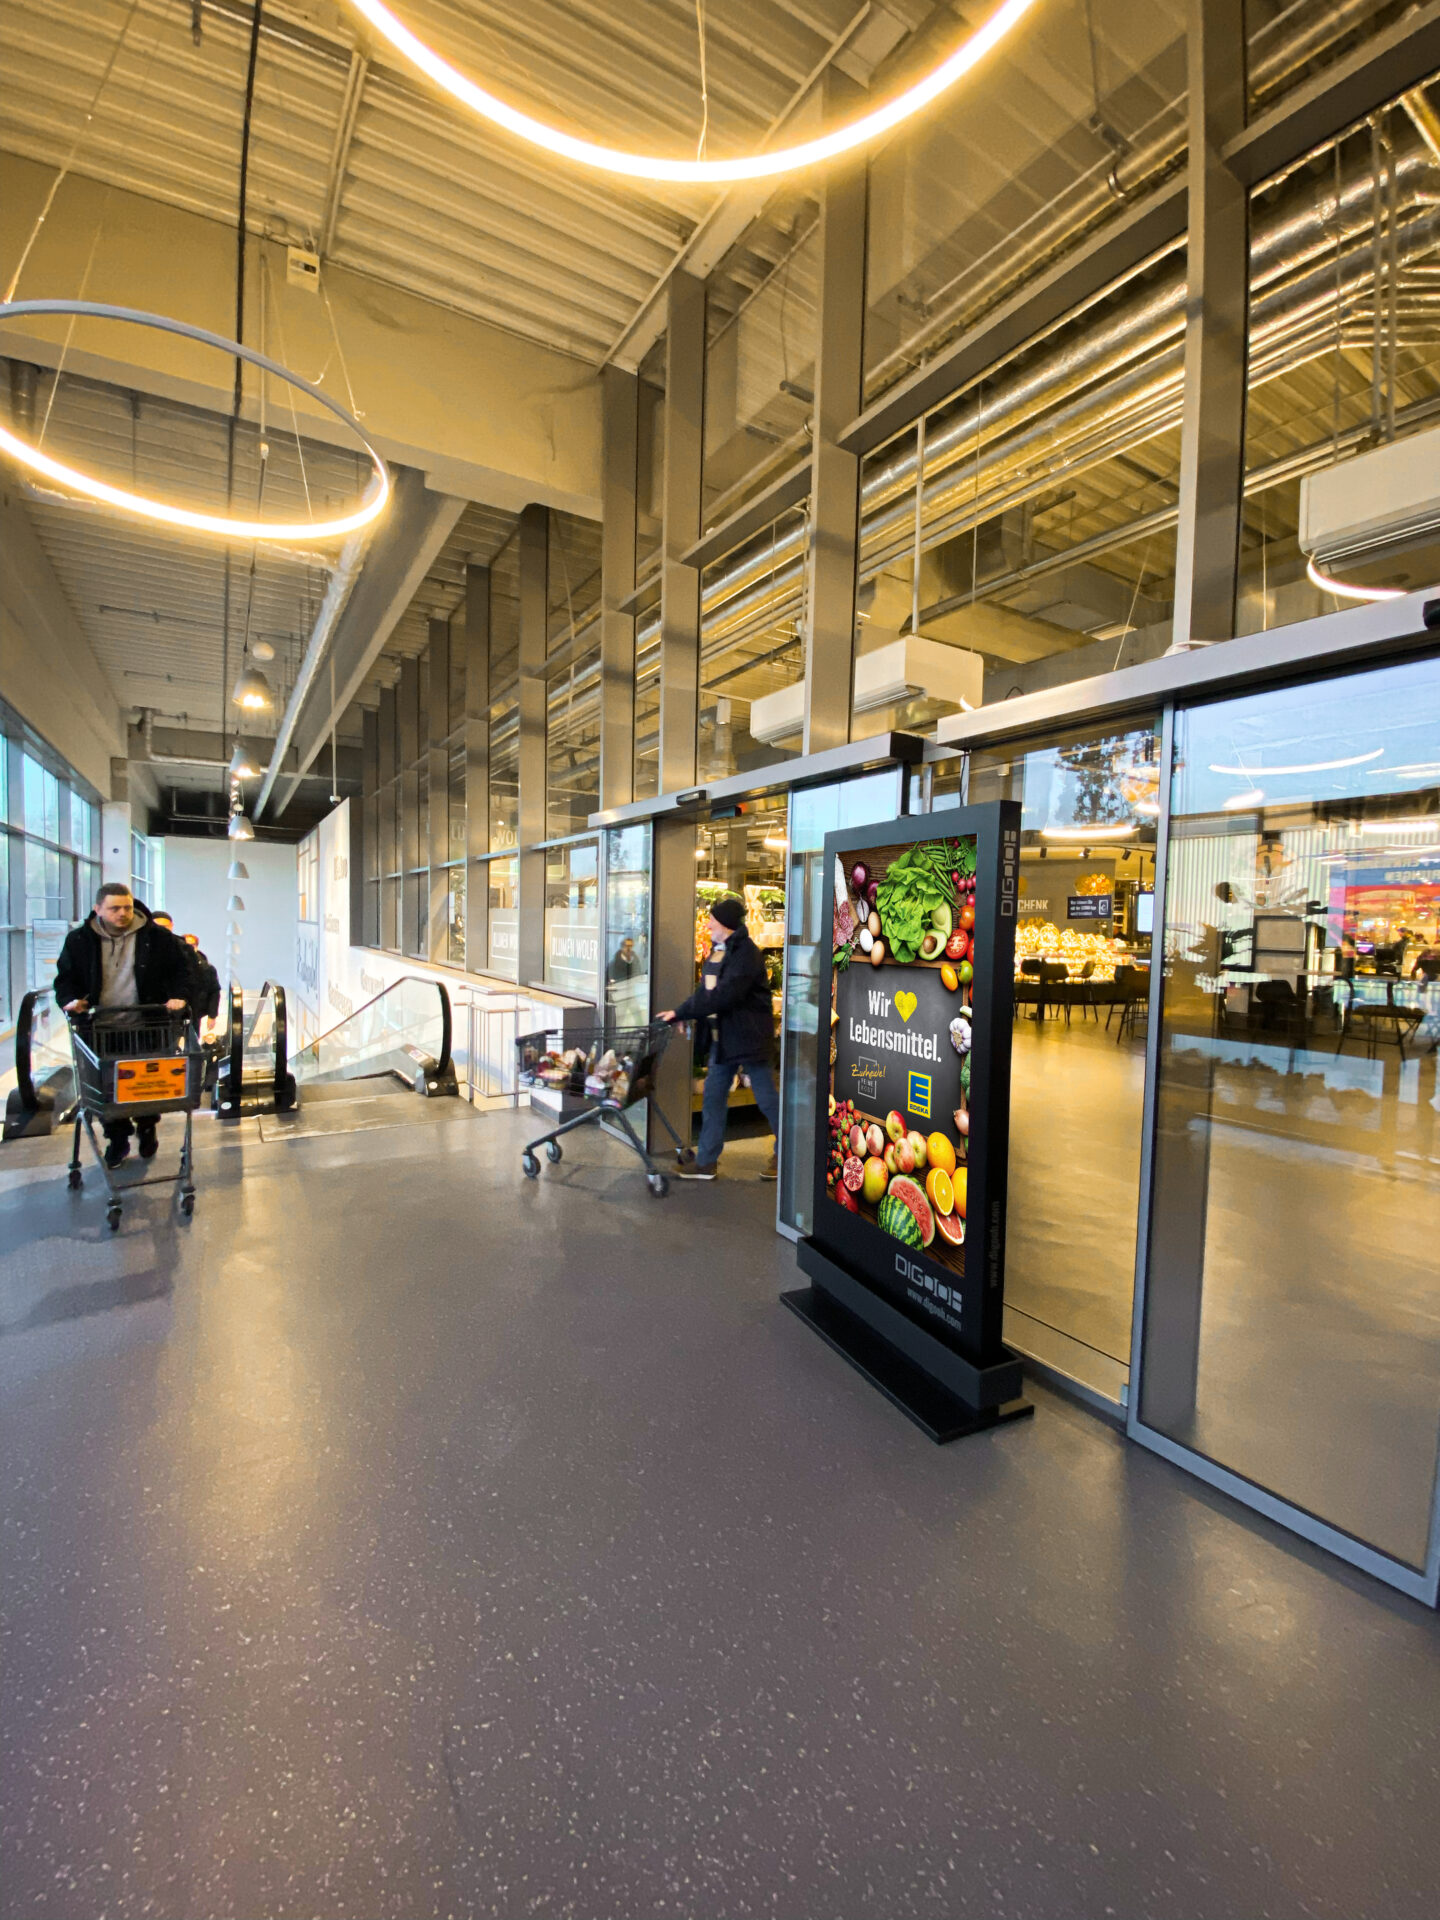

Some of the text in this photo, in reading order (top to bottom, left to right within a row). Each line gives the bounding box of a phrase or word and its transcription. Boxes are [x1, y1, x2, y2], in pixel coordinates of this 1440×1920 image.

[868, 989, 891, 1017] Wir
[849, 1017, 942, 1062] Lebensmittel.
[909, 1103, 929, 1115] EDEKA
